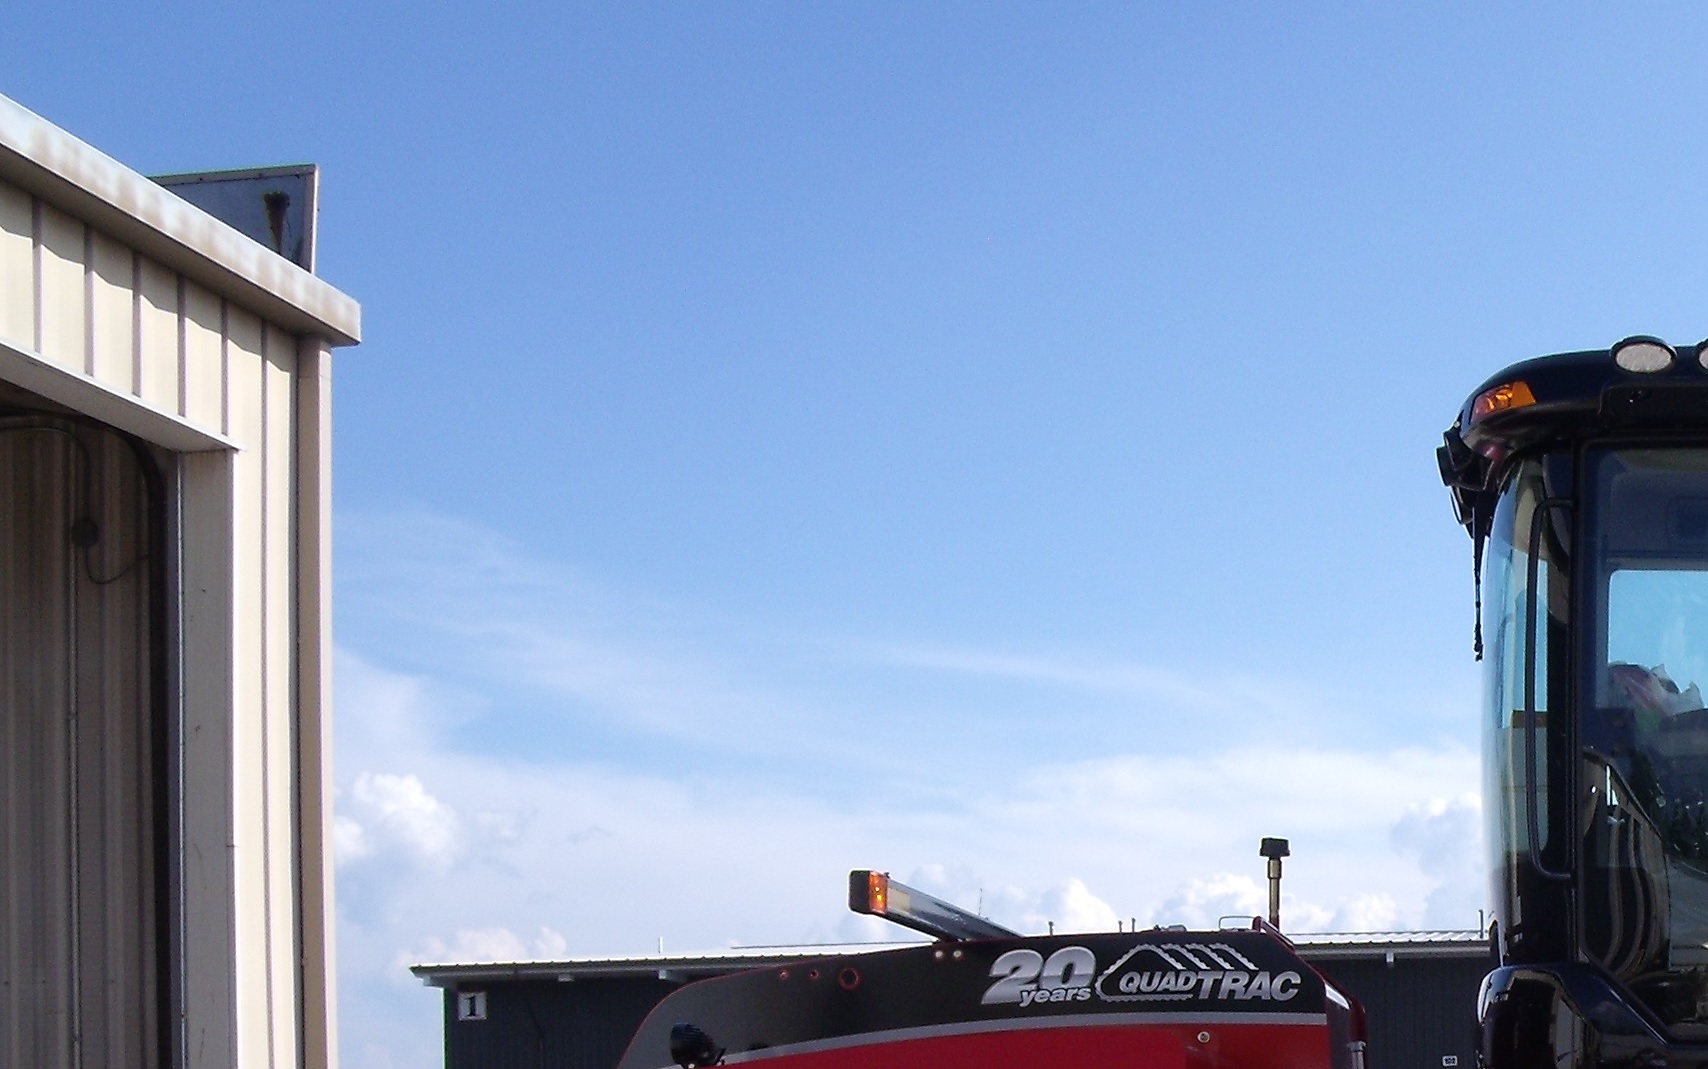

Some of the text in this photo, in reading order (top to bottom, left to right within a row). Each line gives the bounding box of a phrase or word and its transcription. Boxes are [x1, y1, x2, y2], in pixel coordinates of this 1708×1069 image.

[981, 946, 1097, 1004] 20
[465, 995, 477, 1017] 1
[1020, 986, 1091, 1007] years
